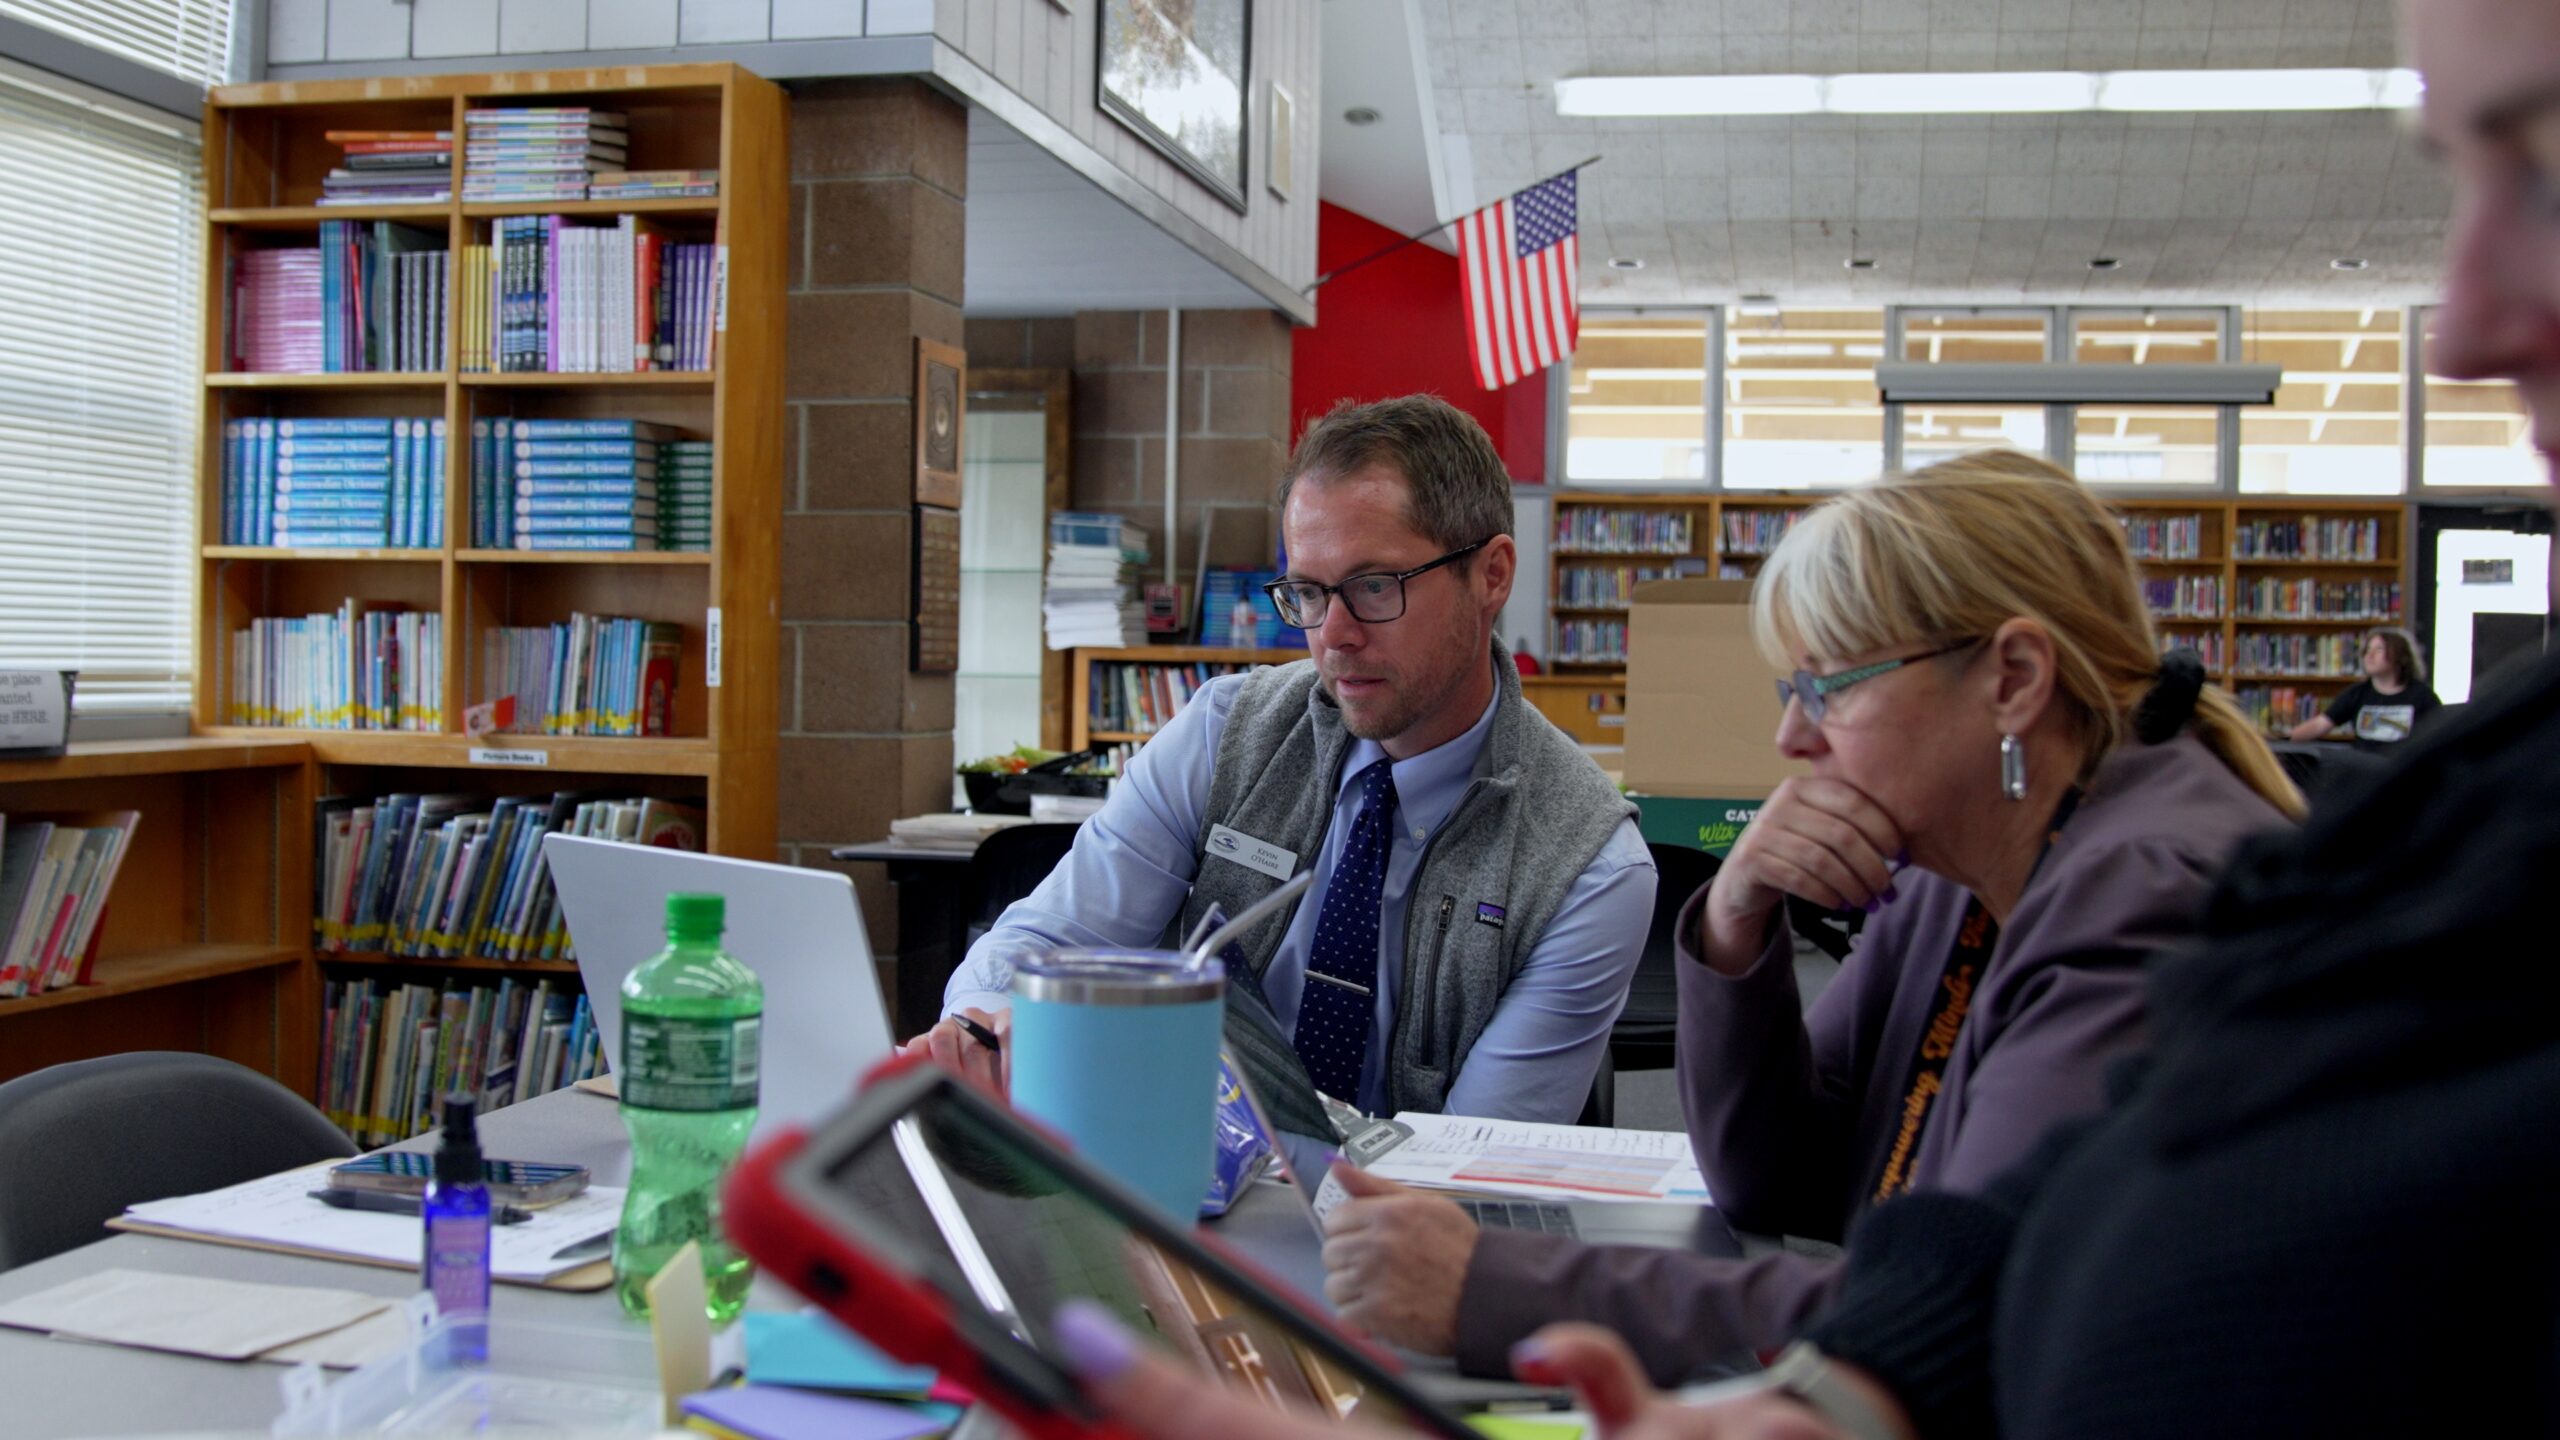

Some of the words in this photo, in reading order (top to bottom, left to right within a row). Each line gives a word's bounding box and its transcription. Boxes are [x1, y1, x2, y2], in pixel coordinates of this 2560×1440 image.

[11, 673, 42, 688] place
[512, 752, 534, 761] Books
[1257, 847, 1279, 860] KEVIN
[1250, 854, 1280, 870] O'HAIRE
